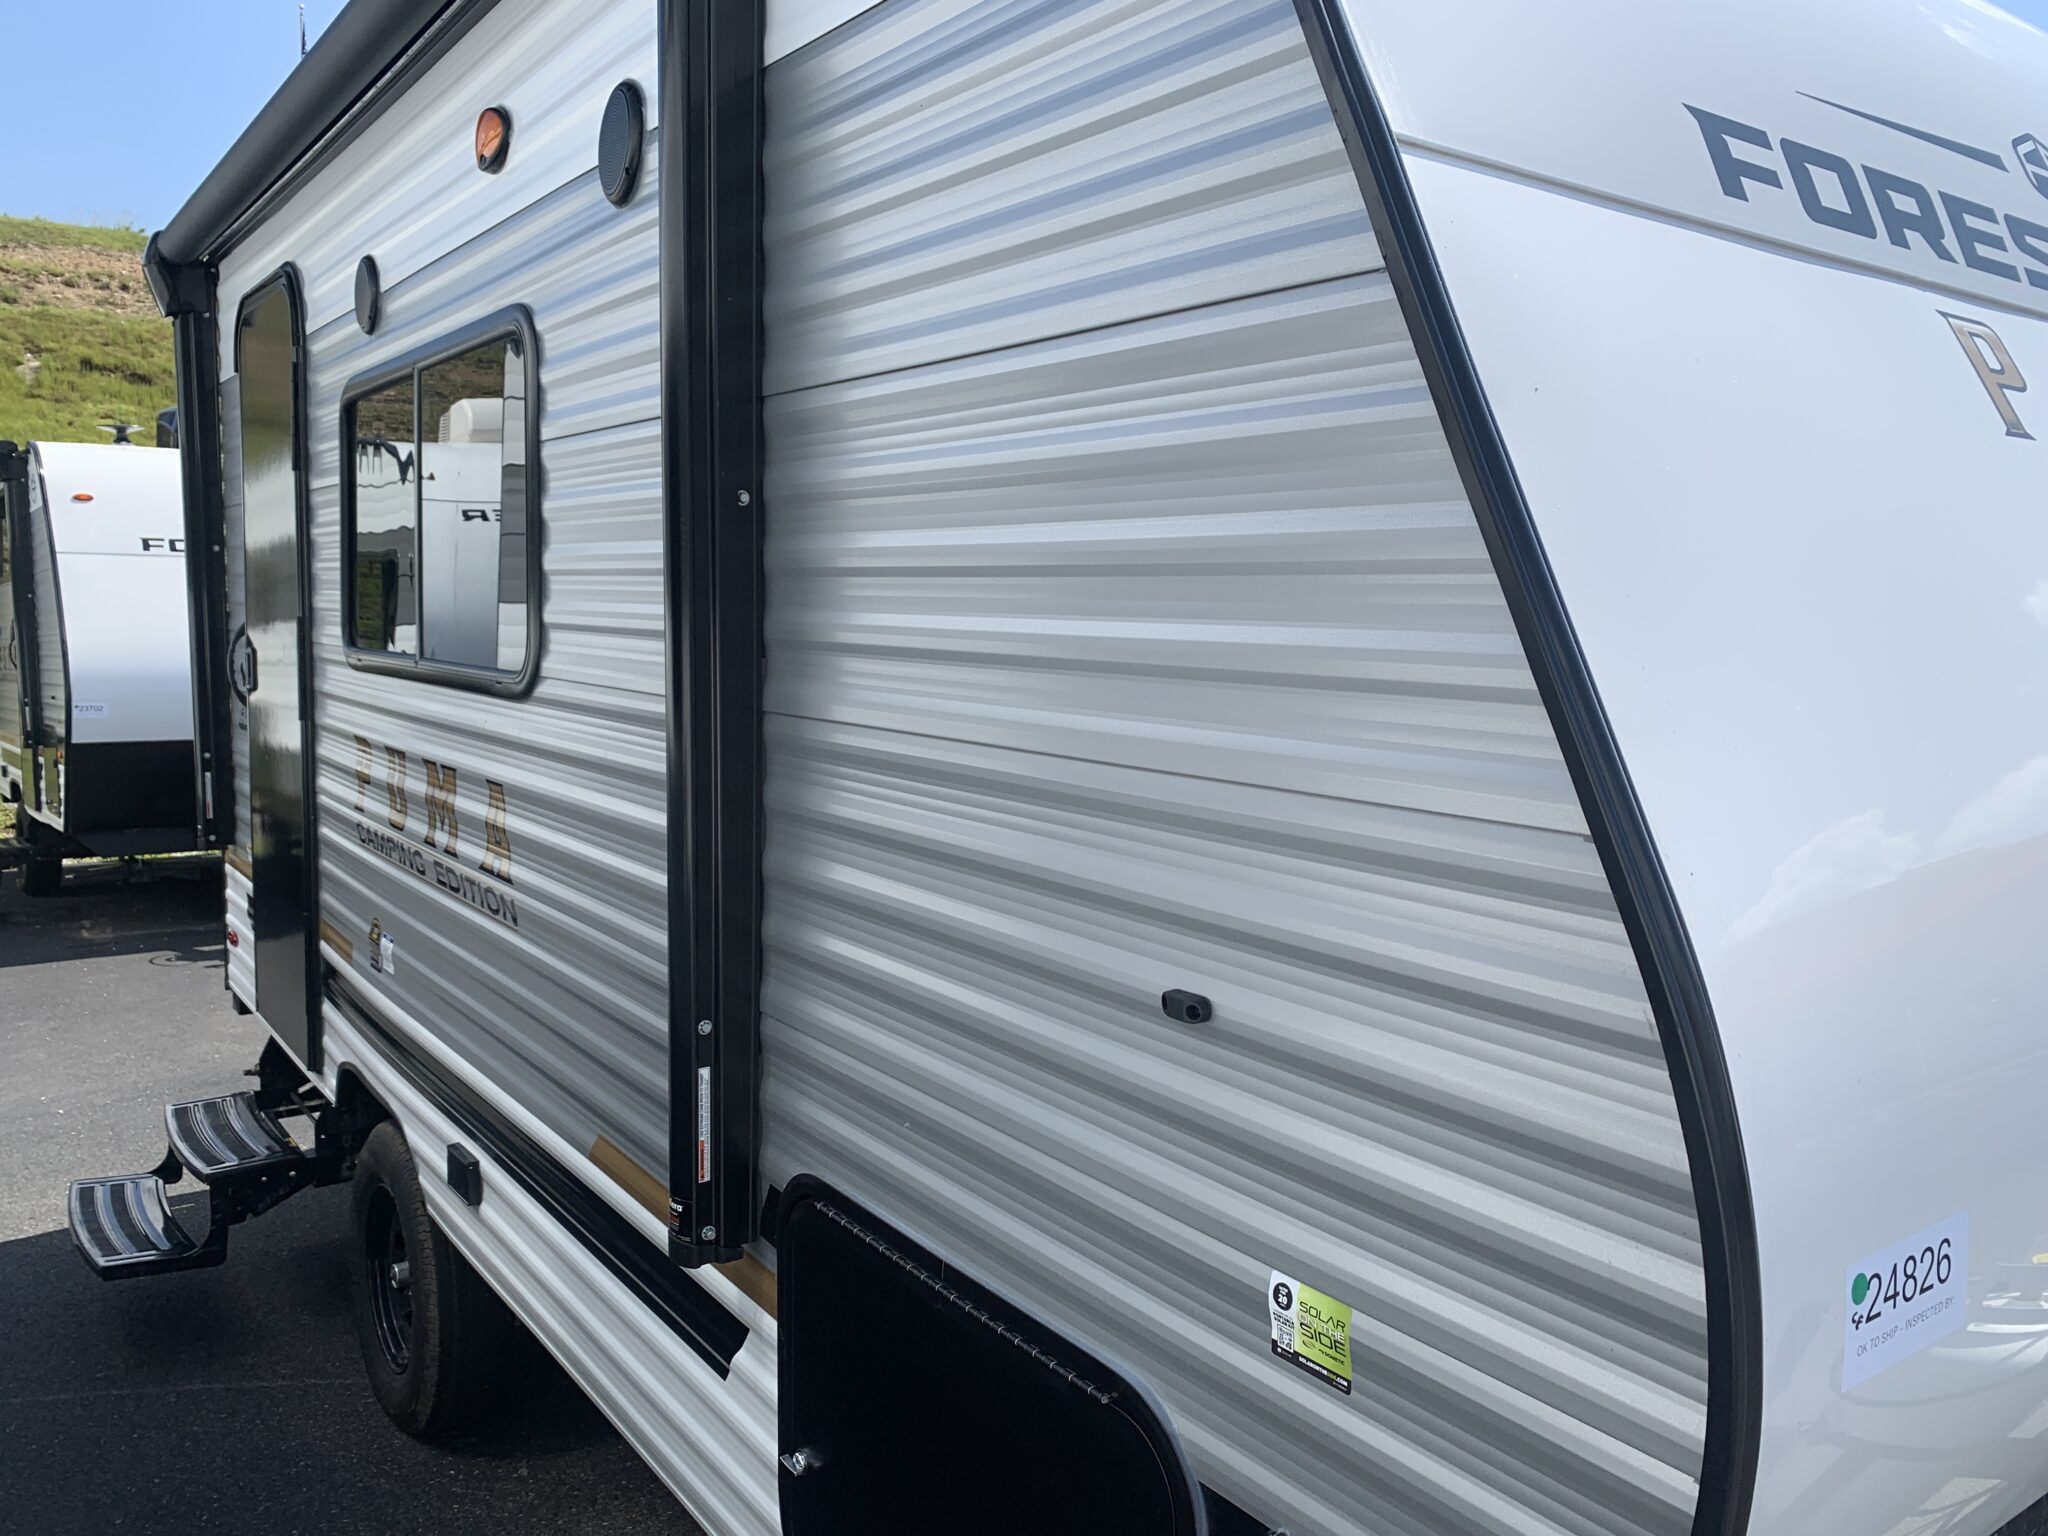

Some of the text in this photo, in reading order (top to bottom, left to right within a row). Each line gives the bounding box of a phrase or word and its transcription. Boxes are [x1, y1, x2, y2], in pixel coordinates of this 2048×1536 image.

[354, 735, 514, 886] PUMA
[356, 822, 519, 928] CAMPING EDITION
[1865, 1238, 1952, 1325] 24826
[1298, 1312, 1317, 1329] ON
[1321, 1324, 1345, 1343] THE
[1299, 1301, 1346, 1333] SOLAR
[1300, 1323, 1346, 1358] SIDE
[1857, 1342, 1868, 1357] OK
[1870, 1335, 1880, 1350] TO
[1881, 1325, 1899, 1344] SHIP
[1905, 1301, 1944, 1331] INSPECTED
